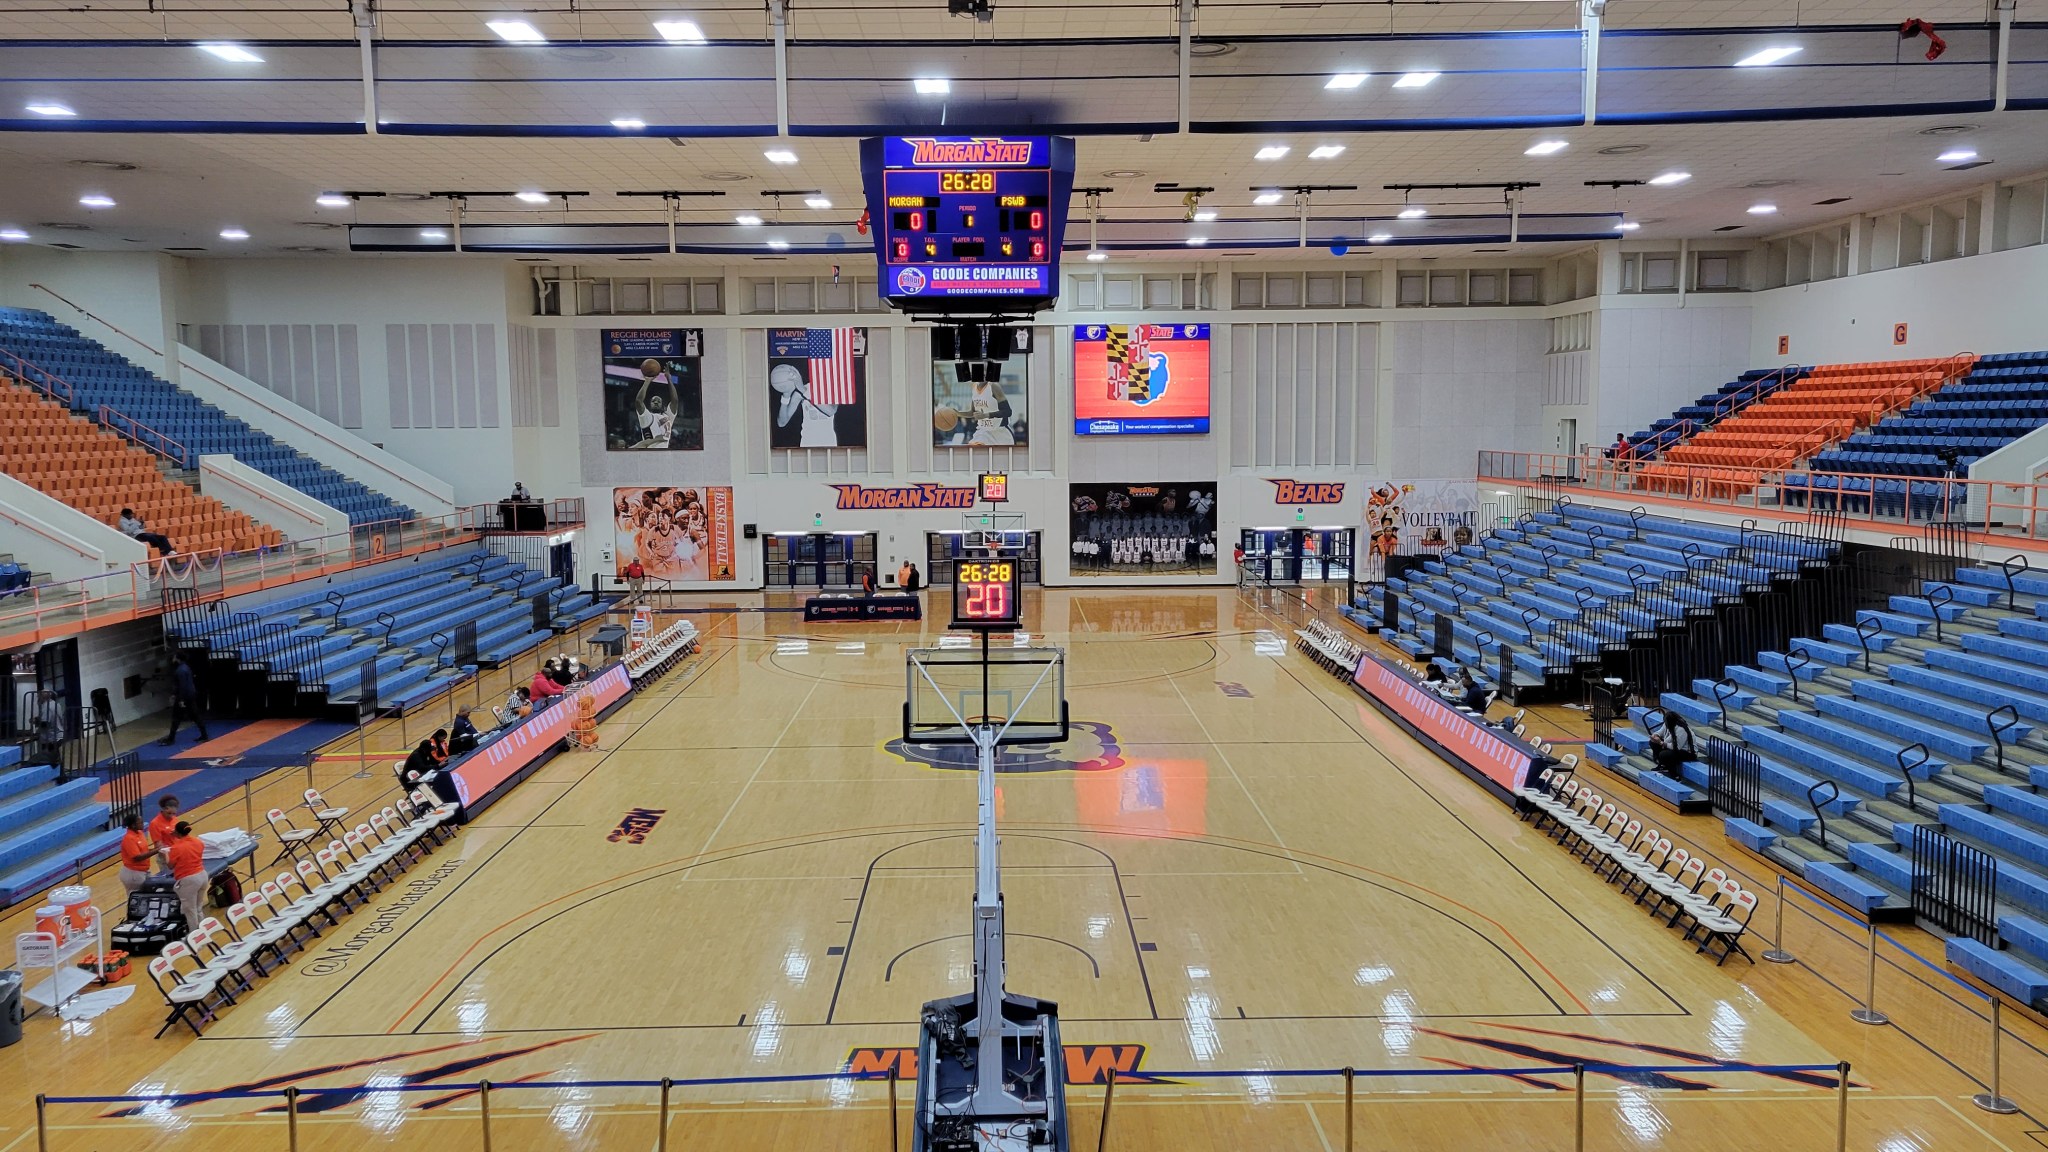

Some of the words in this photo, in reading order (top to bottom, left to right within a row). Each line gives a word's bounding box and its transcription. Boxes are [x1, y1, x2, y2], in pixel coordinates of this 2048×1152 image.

[912, 140, 985, 162] MORGAN
[983, 140, 1029, 162] STATE
[943, 173, 992, 190] 26:28
[889, 196, 923, 207] MORGAN
[1001, 196, 1025, 206] PSWB
[910, 212, 921, 229] 0
[967, 215, 973, 227] 1
[1031, 212, 1041, 229] 0
[898, 243, 907, 256] 0
[926, 244, 936, 255] 4
[1002, 244, 1012, 255] 4
[1033, 243, 1042, 255] 0
[932, 268, 969, 280] GOODE
[973, 268, 1038, 280] COMPANIES
[776, 330, 806, 338] MARVIN
[1151, 327, 1172, 337] STATE
[1895, 325, 1905, 342] G
[1780, 337, 1787, 352] F
[983, 476, 1005, 484] 26:28
[836, 484, 922, 509] MORGAN
[919, 484, 976, 508] STATE
[986, 484, 1002, 497] 20
[1274, 479, 1344, 504] BEARS
[1695, 480, 1701, 498] 3
[715, 492, 728, 563] BASKETBALL
[1401, 512, 1477, 527] VOLLEYBALL
[375, 537, 381, 554] 2
[960, 564, 1010, 582] 26:28
[966, 584, 1003, 615] 20
[1439, 704, 1469, 739] STATE
[486, 737, 513, 766] THIS
[513, 728, 527, 747] IS
[300, 859, 466, 977] @MorganStateBears
